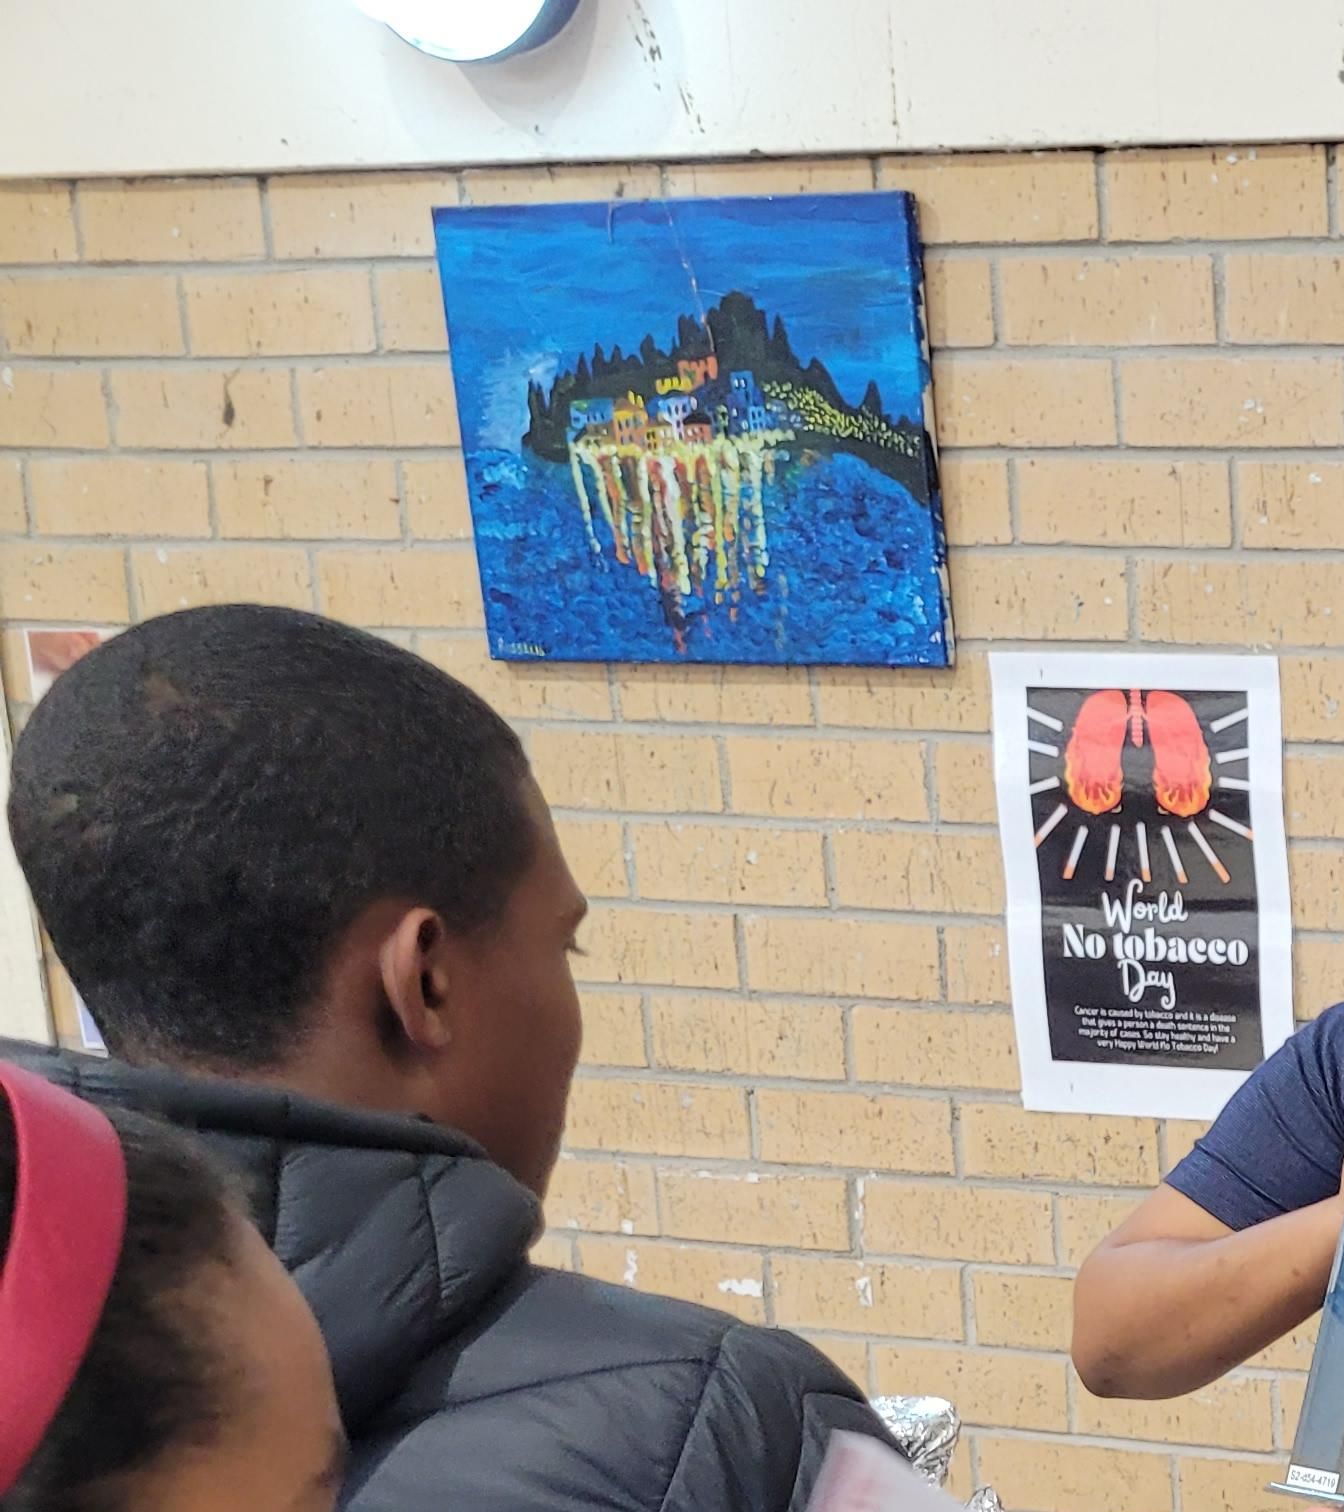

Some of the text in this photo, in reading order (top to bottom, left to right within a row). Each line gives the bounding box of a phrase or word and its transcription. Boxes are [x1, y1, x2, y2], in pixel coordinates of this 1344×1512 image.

[1102, 880, 1188, 934] World
[1062, 923, 1249, 966] No tobacco
[1117, 958, 1176, 1011] Day
[1074, 1005, 1099, 1016] Cancer
[1100, 1008, 1107, 1016] is
[1108, 1008, 1133, 1018] caused
[1134, 1008, 1143, 1019] by
[1144, 1009, 1173, 1020] tobacco
[1175, 1011, 1188, 1020] and
[1209, 1012, 1237, 1023] disease
[1082, 1017, 1096, 1026] that
[1098, 1019, 1116, 1028] gives
[1123, 1020, 1149, 1030] person
[1156, 1020, 1176, 1030] death
[1177, 1022, 1209, 1031] sentence
[1210, 1023, 1217, 1031] in
[1218, 1023, 1230, 1032] the
[1078, 1028, 1109, 1038] majority
[1110, 1028, 1118, 1037] of
[1119, 1030, 1141, 1039] cases.
[1142, 1029, 1153, 1039] So
[1155, 1031, 1170, 1041] stay
[1170, 1031, 1196, 1043] healthy
[1197, 1033, 1211, 1042] and
[1211, 1032, 1229, 1043] have
[1097, 1039, 1114, 1049] very
[1114, 1039, 1136, 1051] Happy
[1137, 1040, 1159, 1050] World
[1160, 1041, 1171, 1050] No
[1171, 1041, 1202, 1052] Tobacco
